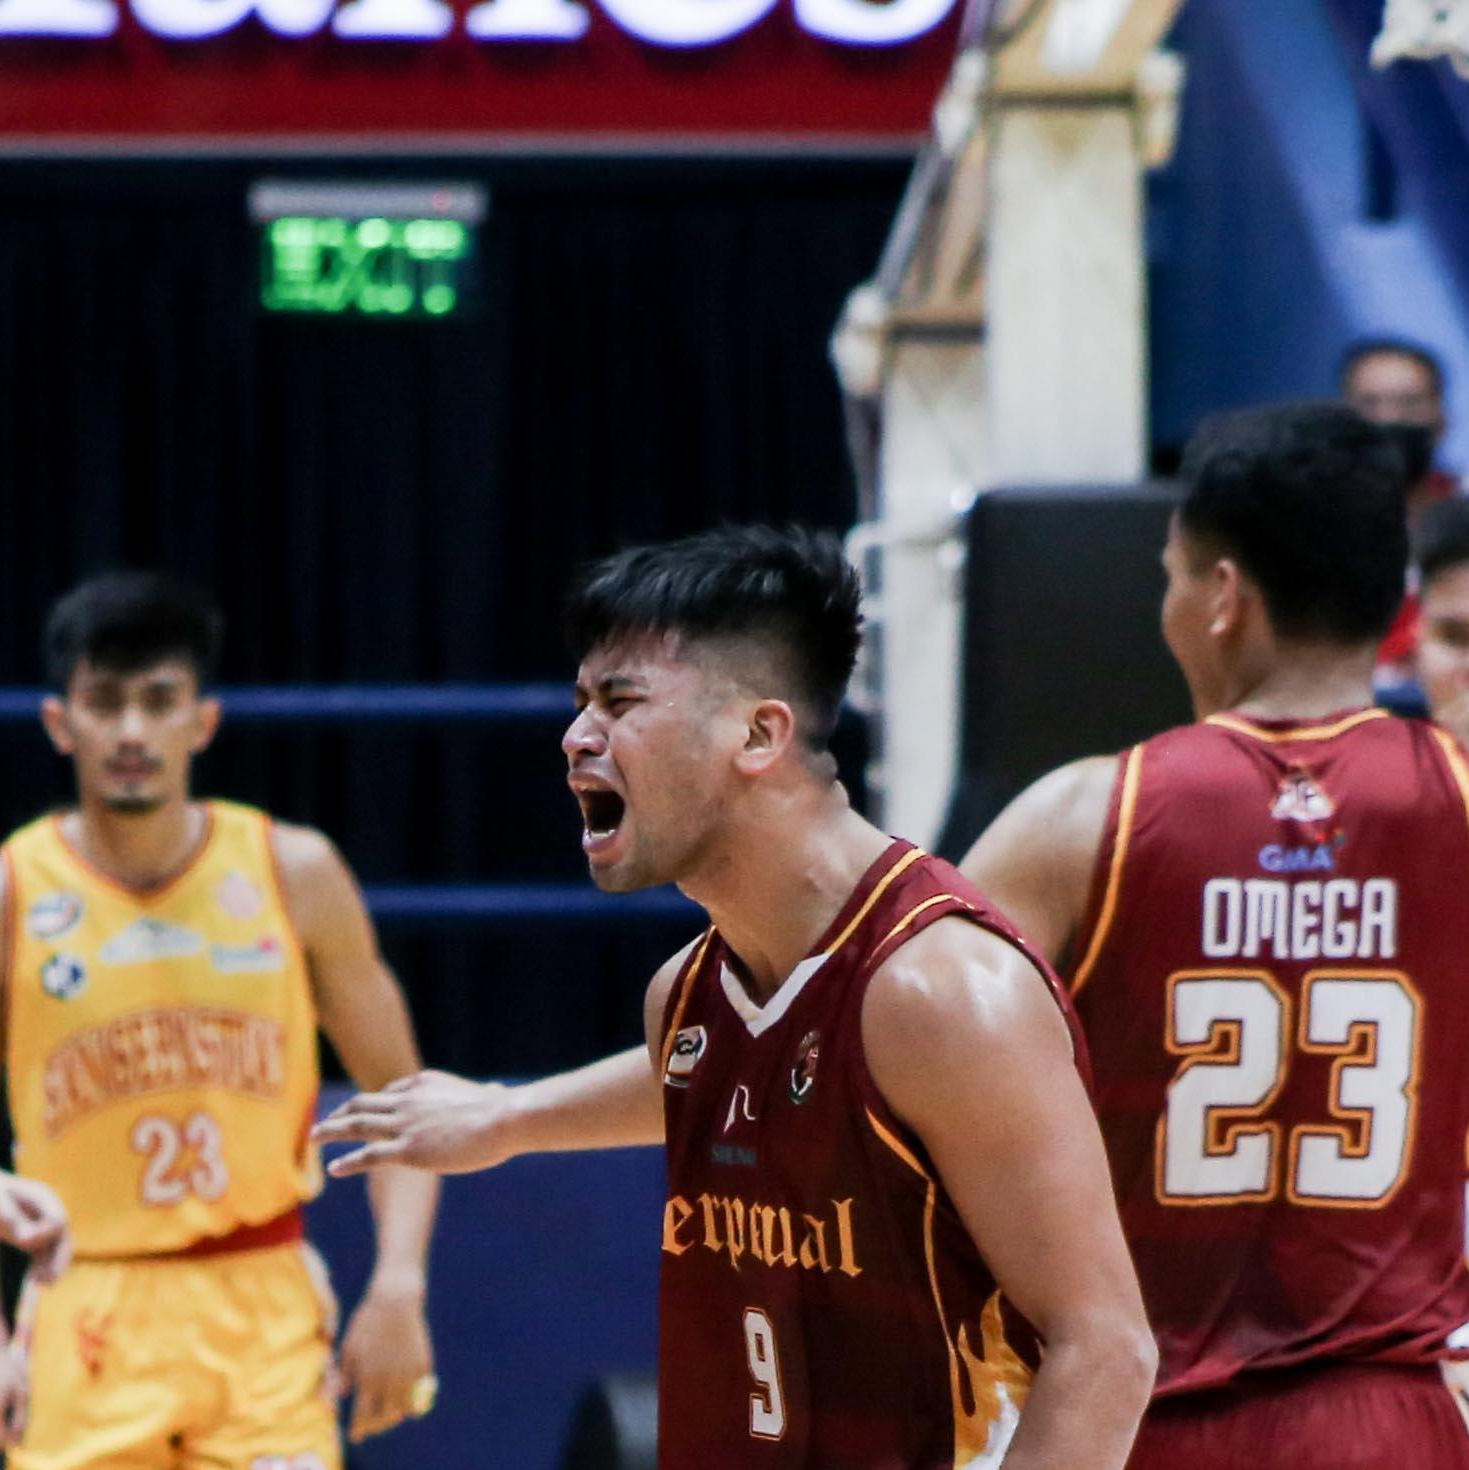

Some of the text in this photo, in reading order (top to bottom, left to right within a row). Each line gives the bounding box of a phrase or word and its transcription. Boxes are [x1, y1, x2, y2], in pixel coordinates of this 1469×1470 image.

[1202, 878, 1397, 960] OMEGA
[1156, 969, 1423, 1209] 23
[133, 1111, 229, 1207] 23
[743, 1306, 787, 1441] 9
